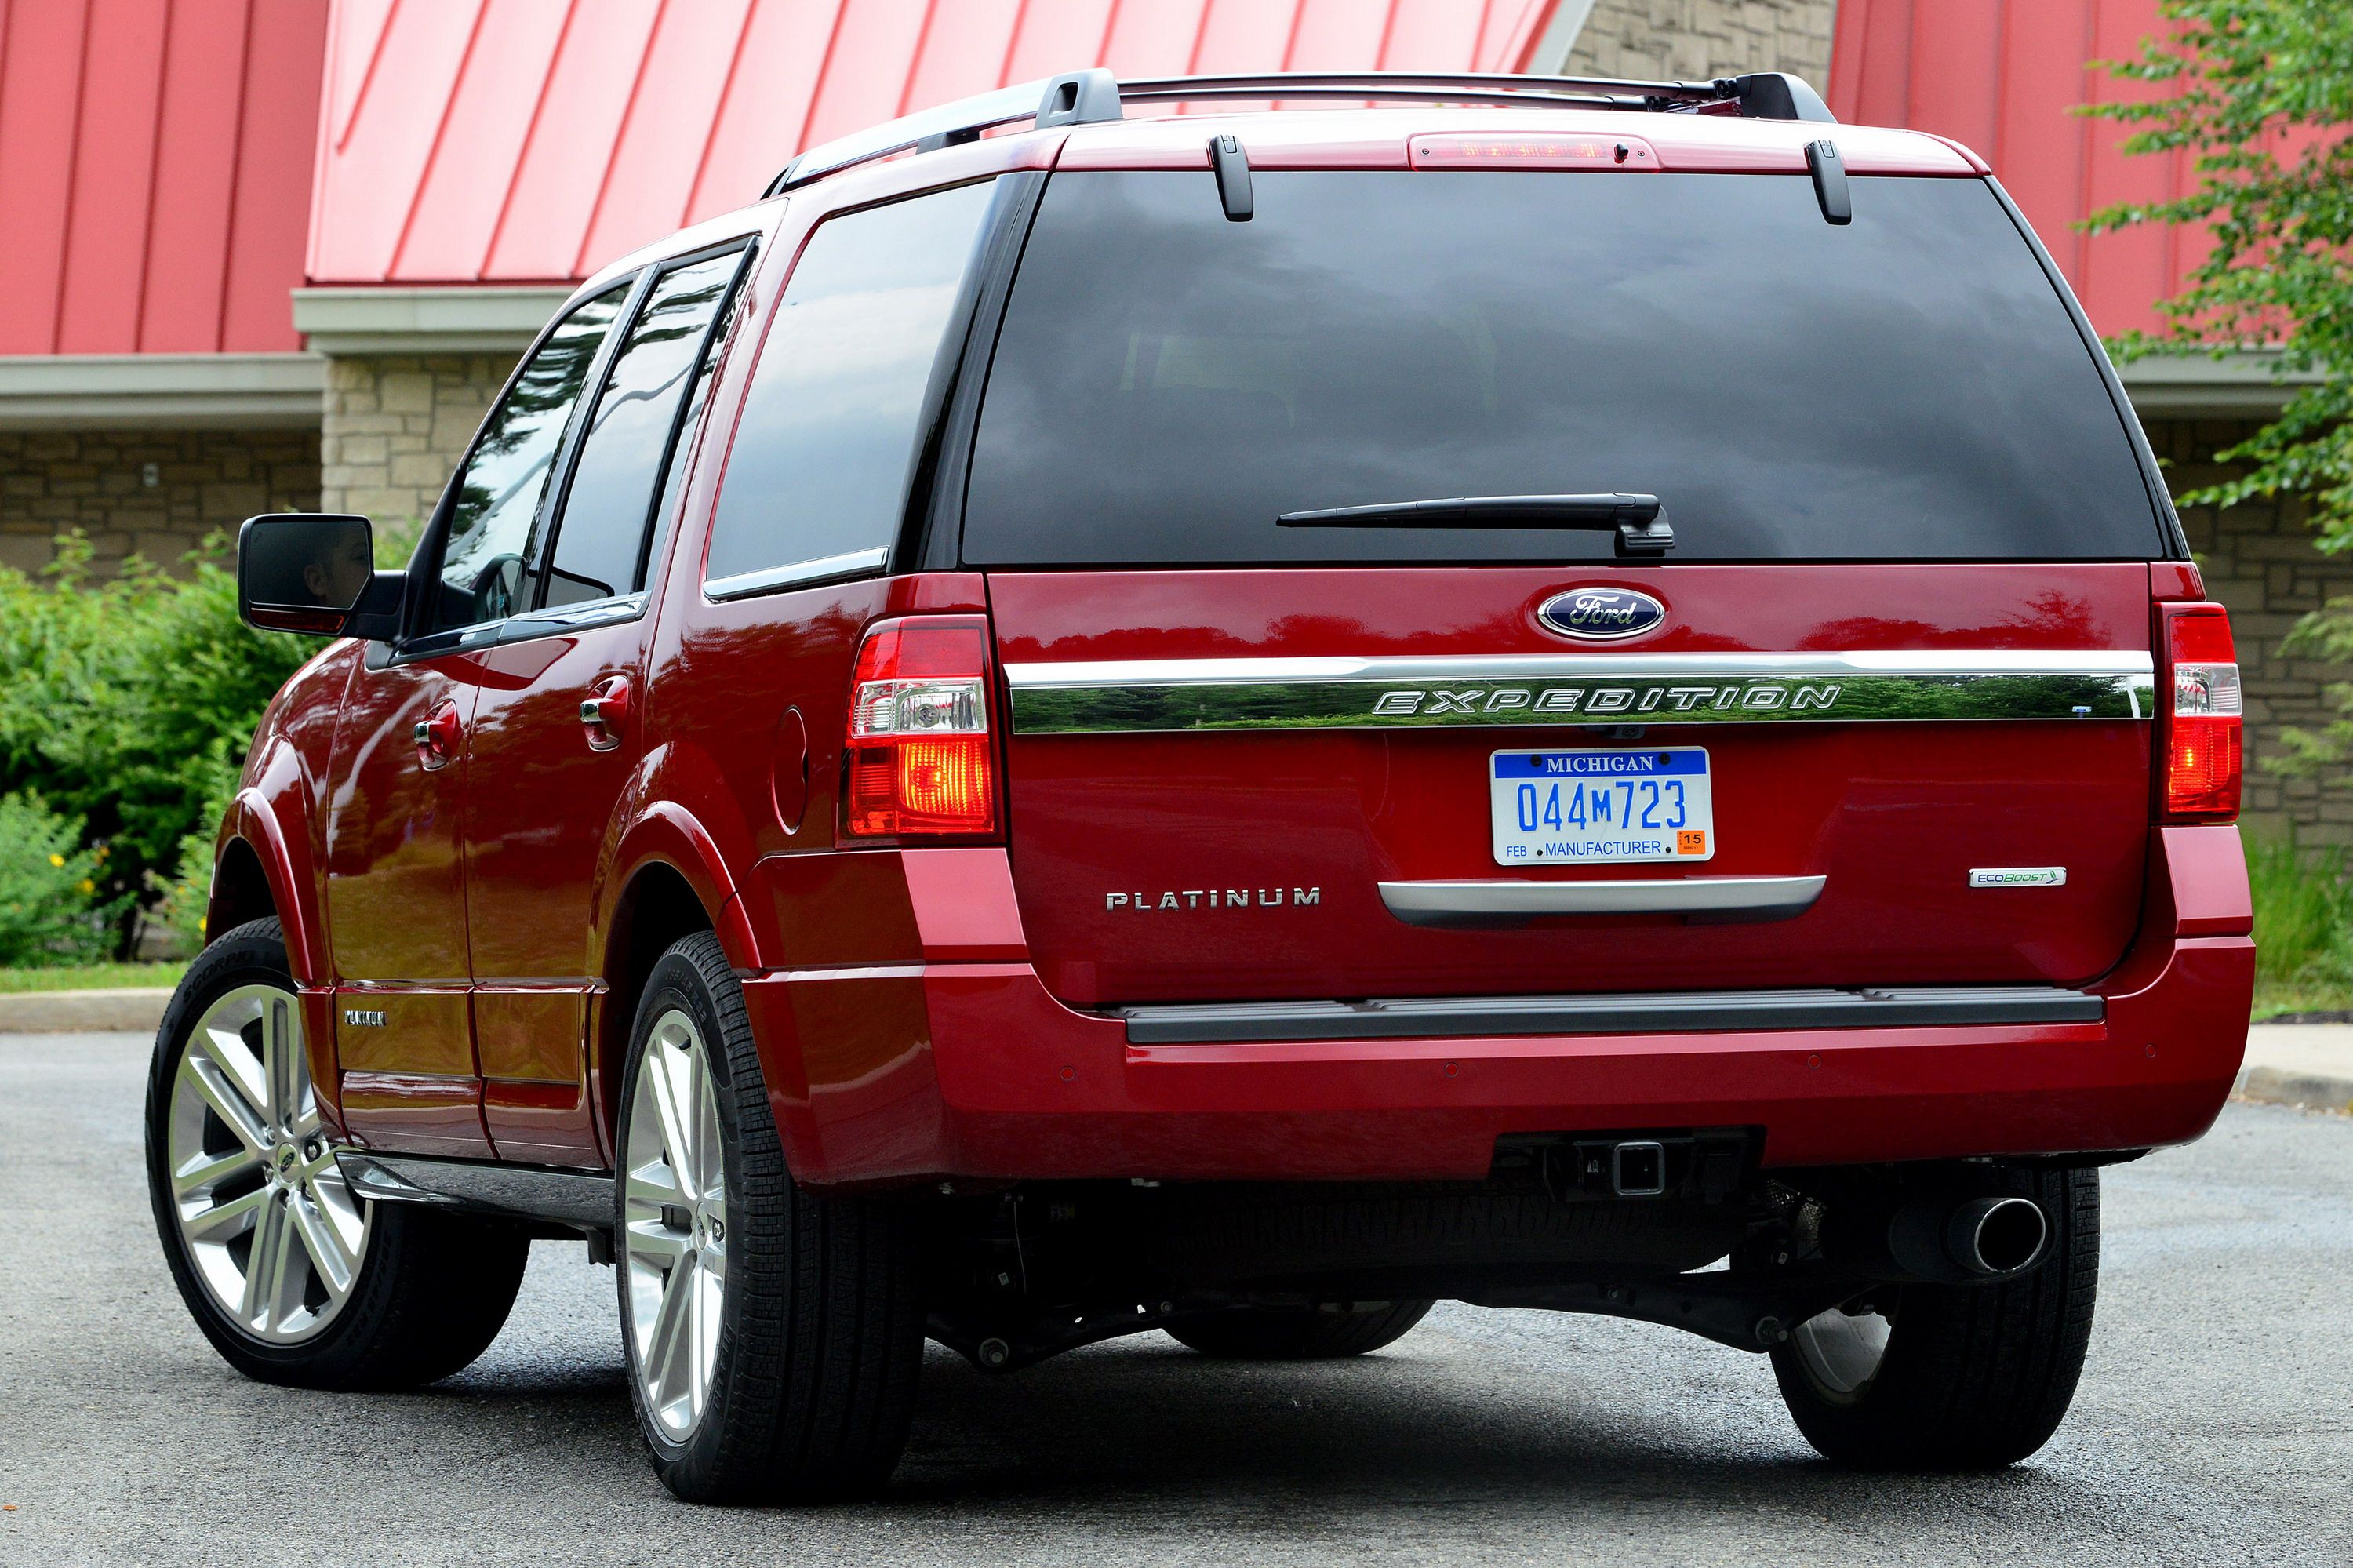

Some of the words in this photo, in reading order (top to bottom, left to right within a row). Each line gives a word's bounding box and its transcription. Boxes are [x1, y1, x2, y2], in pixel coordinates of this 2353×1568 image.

[1569, 595, 1637, 626] Ford
[1373, 686, 1842, 713] EXPEDITION
[1546, 755, 1653, 773] MICHIGAN
[1517, 780, 1686, 831] 044M723
[1507, 846, 1527, 857] FEB
[1545, 840, 1661, 857] MANUFACTURER
[1684, 834, 1702, 844] 15
[1978, 873, 2047, 883] ECOBOOST
[1106, 886, 1320, 911] PLATINUM
